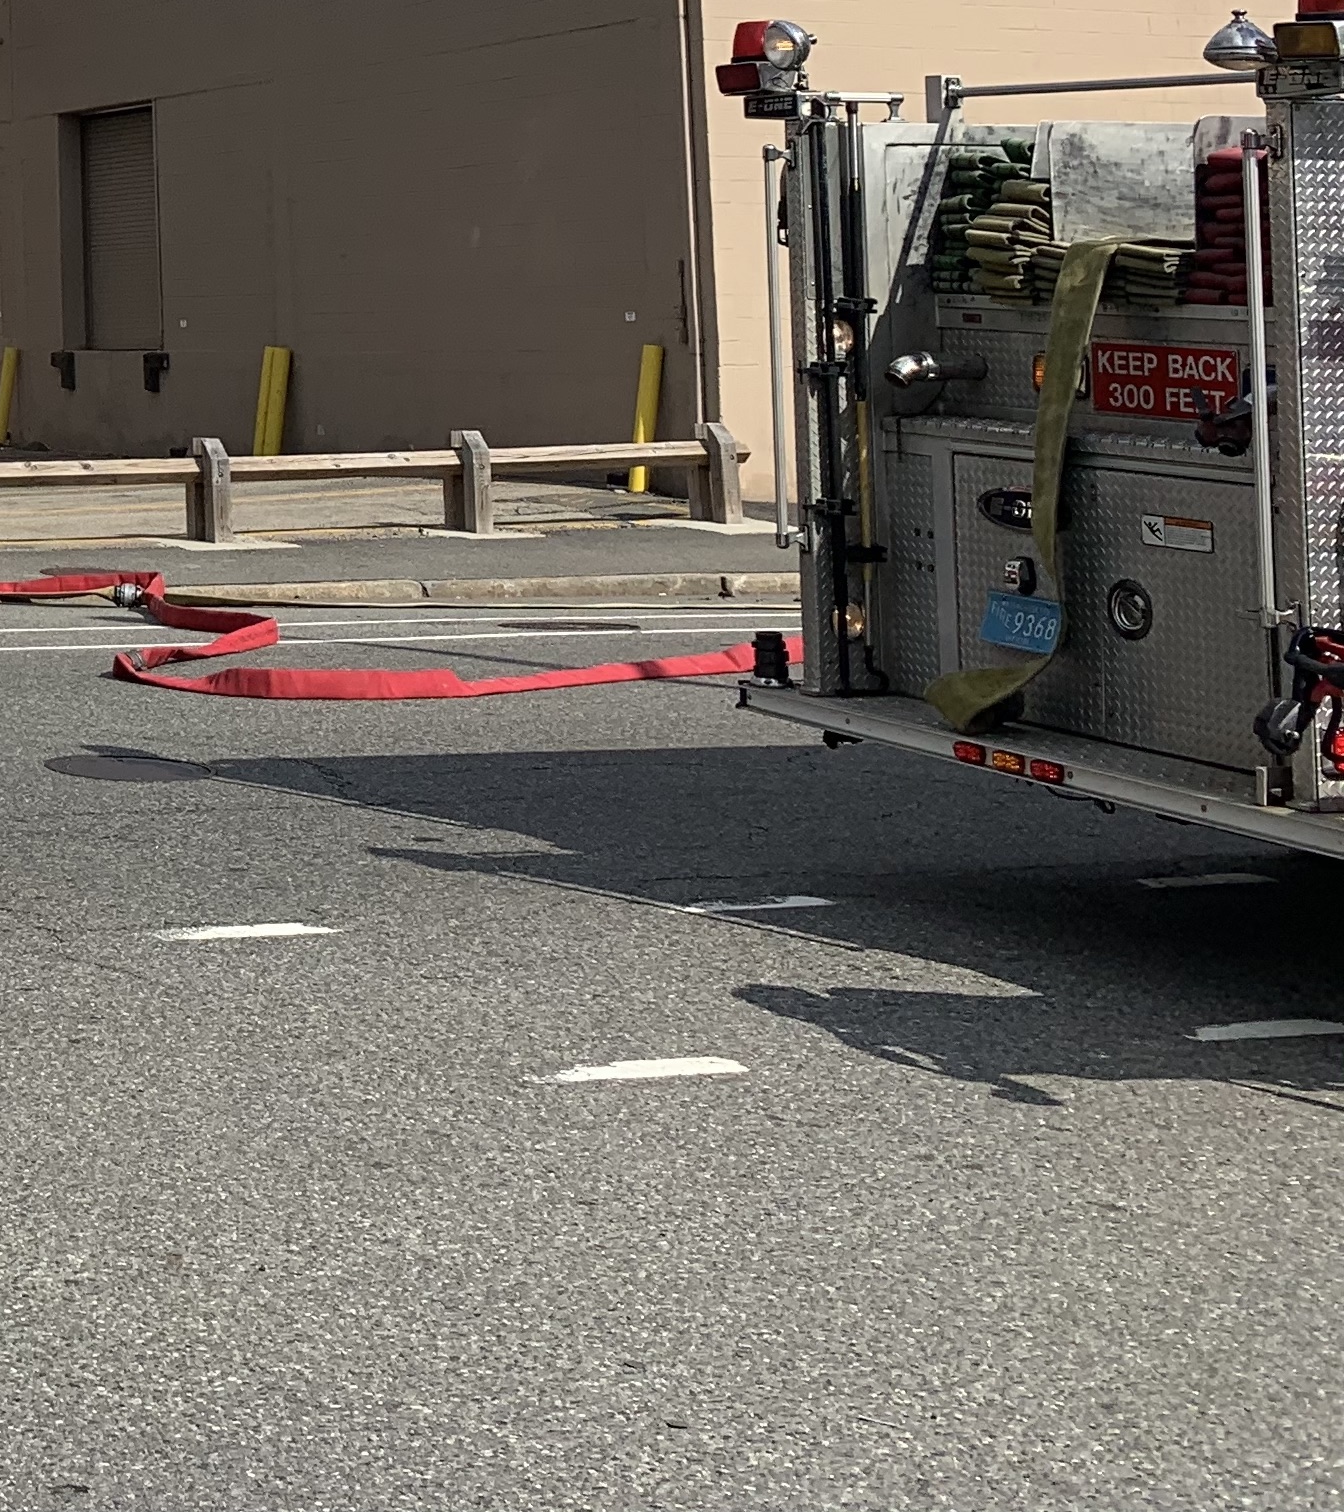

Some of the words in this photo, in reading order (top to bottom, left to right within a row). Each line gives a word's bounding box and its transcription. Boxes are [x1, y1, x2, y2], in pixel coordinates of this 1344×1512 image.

[1097, 349, 1158, 376] KEEP
[1168, 354, 1234, 382] BACK
[1108, 382, 1155, 409] 300
[1012, 611, 1057, 640] 9368
